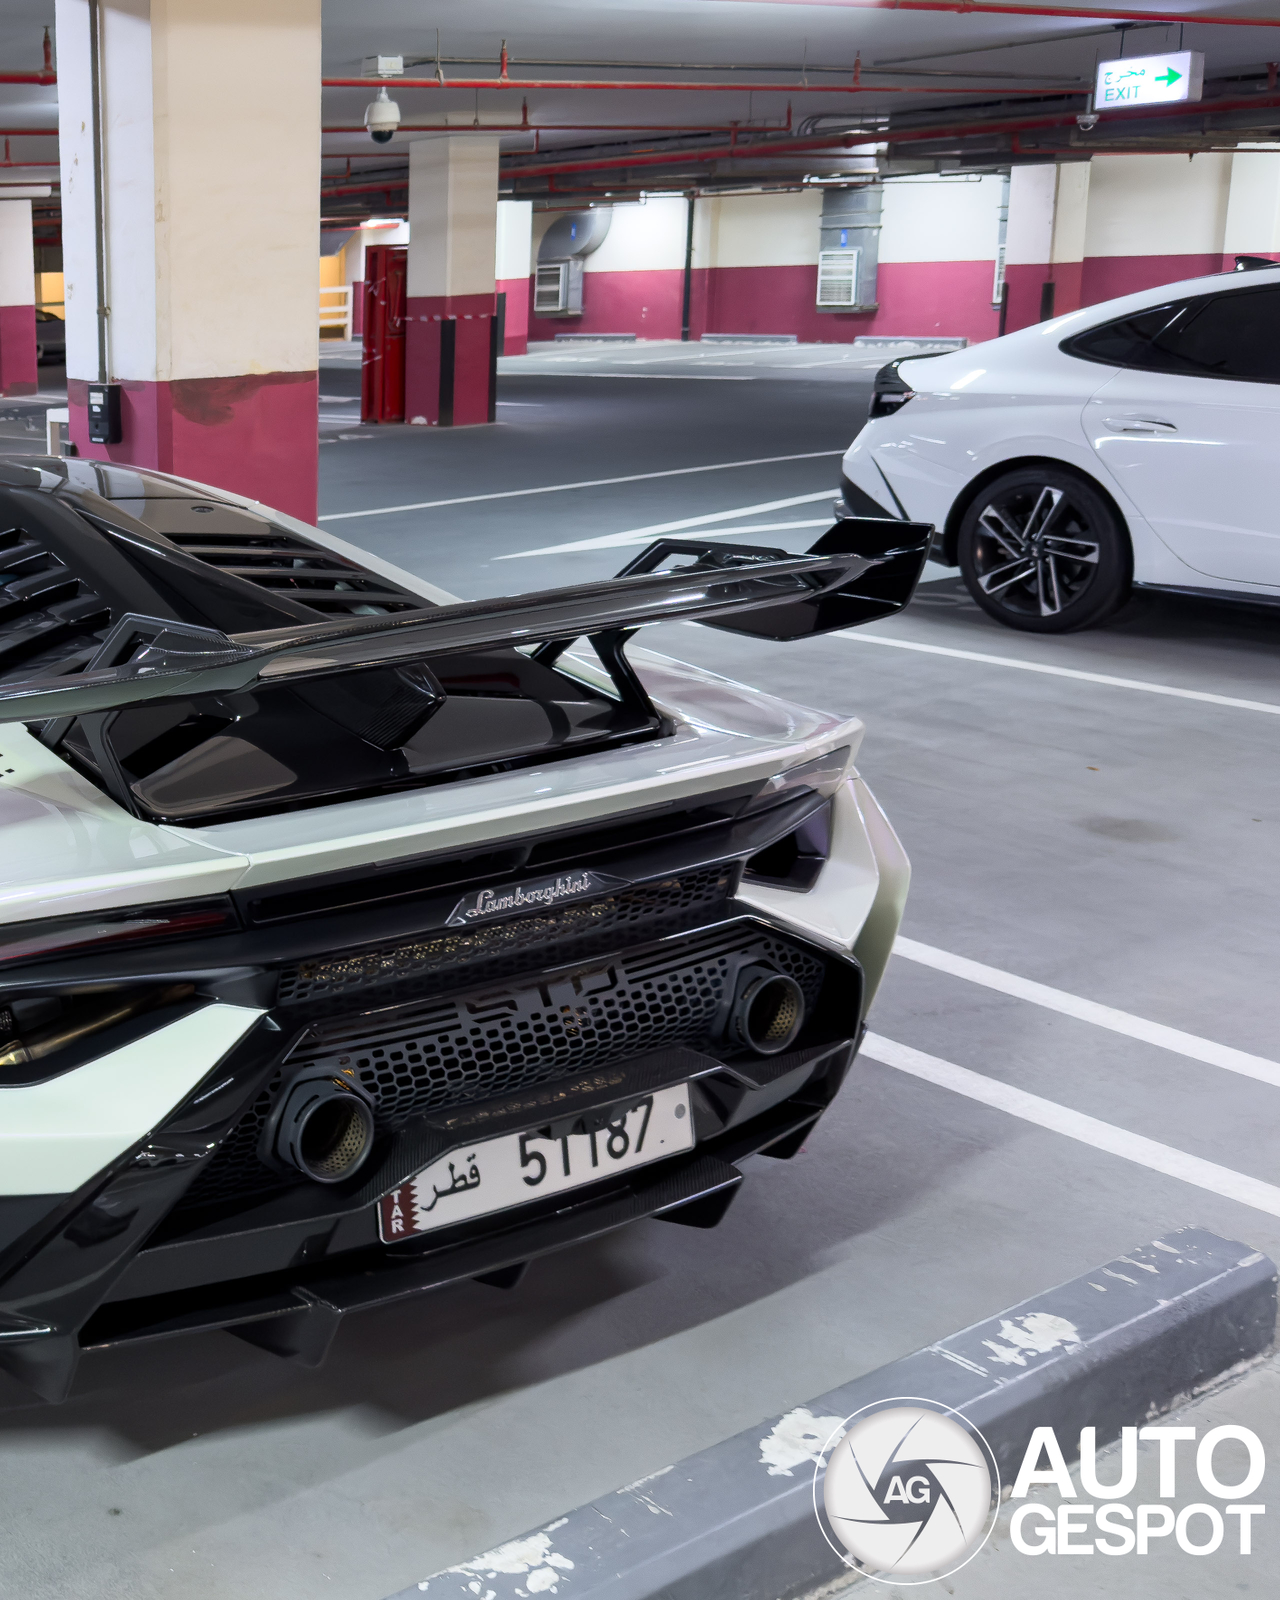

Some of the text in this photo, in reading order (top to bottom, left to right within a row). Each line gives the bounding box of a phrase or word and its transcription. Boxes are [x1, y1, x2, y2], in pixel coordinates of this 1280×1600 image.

[1104, 66, 1146, 85] مخرج
[1104, 85, 1141, 101] EXIT
[465, 872, 591, 918] Lamborghini
[420, 1153, 481, 1212] قطر
[389, 1190, 405, 1234] TAR
